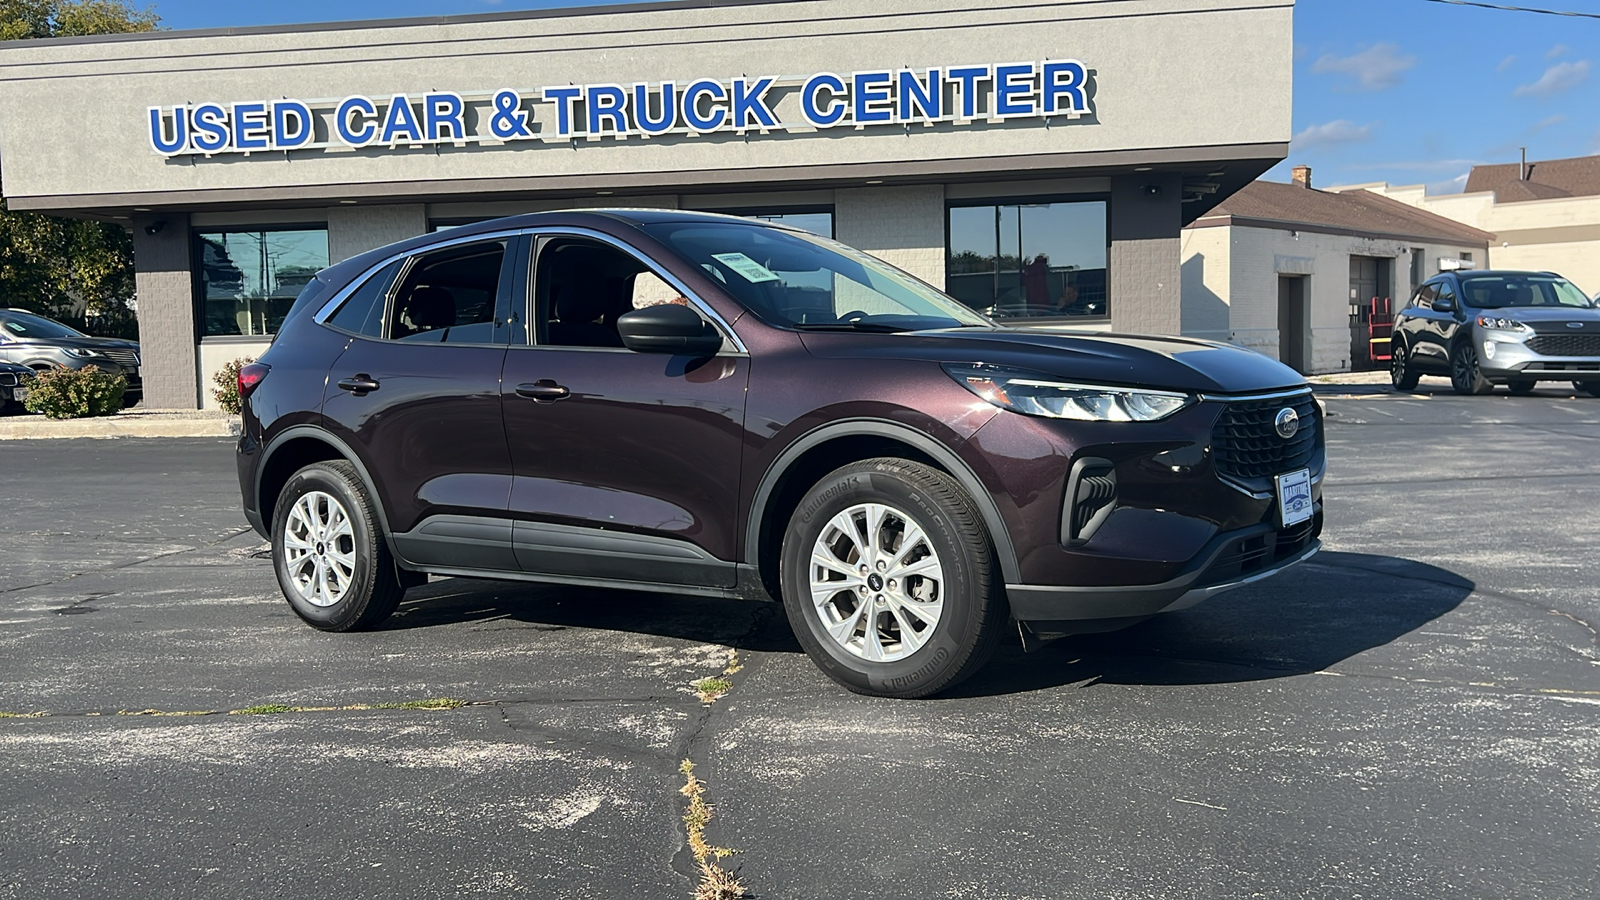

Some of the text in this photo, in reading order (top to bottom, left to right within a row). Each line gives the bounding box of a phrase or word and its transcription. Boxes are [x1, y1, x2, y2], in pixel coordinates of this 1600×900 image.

[148, 58, 1092, 156] USED CAR & TRUCK CENTER
[802, 478, 852, 524] Continental
[889, 646, 949, 688] Continental
